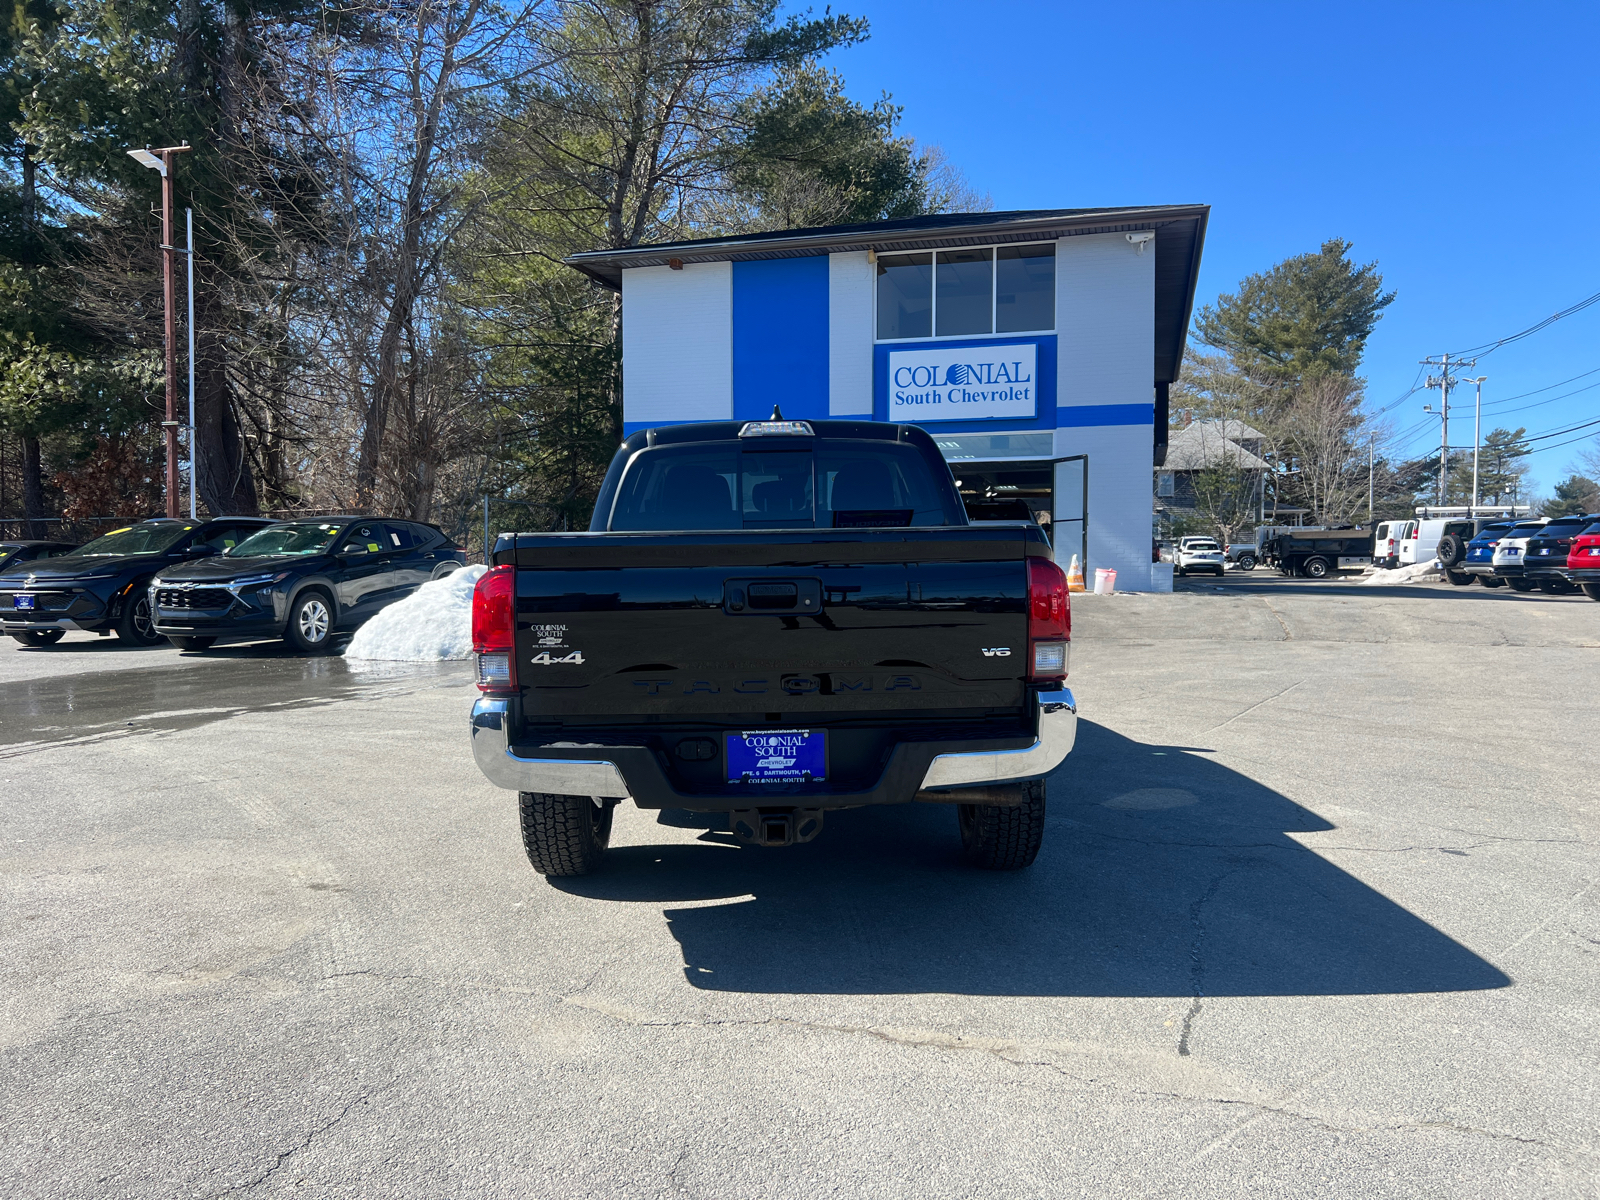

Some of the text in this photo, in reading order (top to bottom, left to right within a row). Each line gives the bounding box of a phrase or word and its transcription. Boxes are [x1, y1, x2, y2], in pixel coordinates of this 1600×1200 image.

[894, 362, 1031, 388] COLONIAL
[895, 387, 1030, 405] South Chevrolet
[981, 647, 1011, 657] V6
[631, 674, 923, 695] TACOMA
[746, 736, 806, 747] COLONIAL
[755, 747, 797, 756] SOUTH
